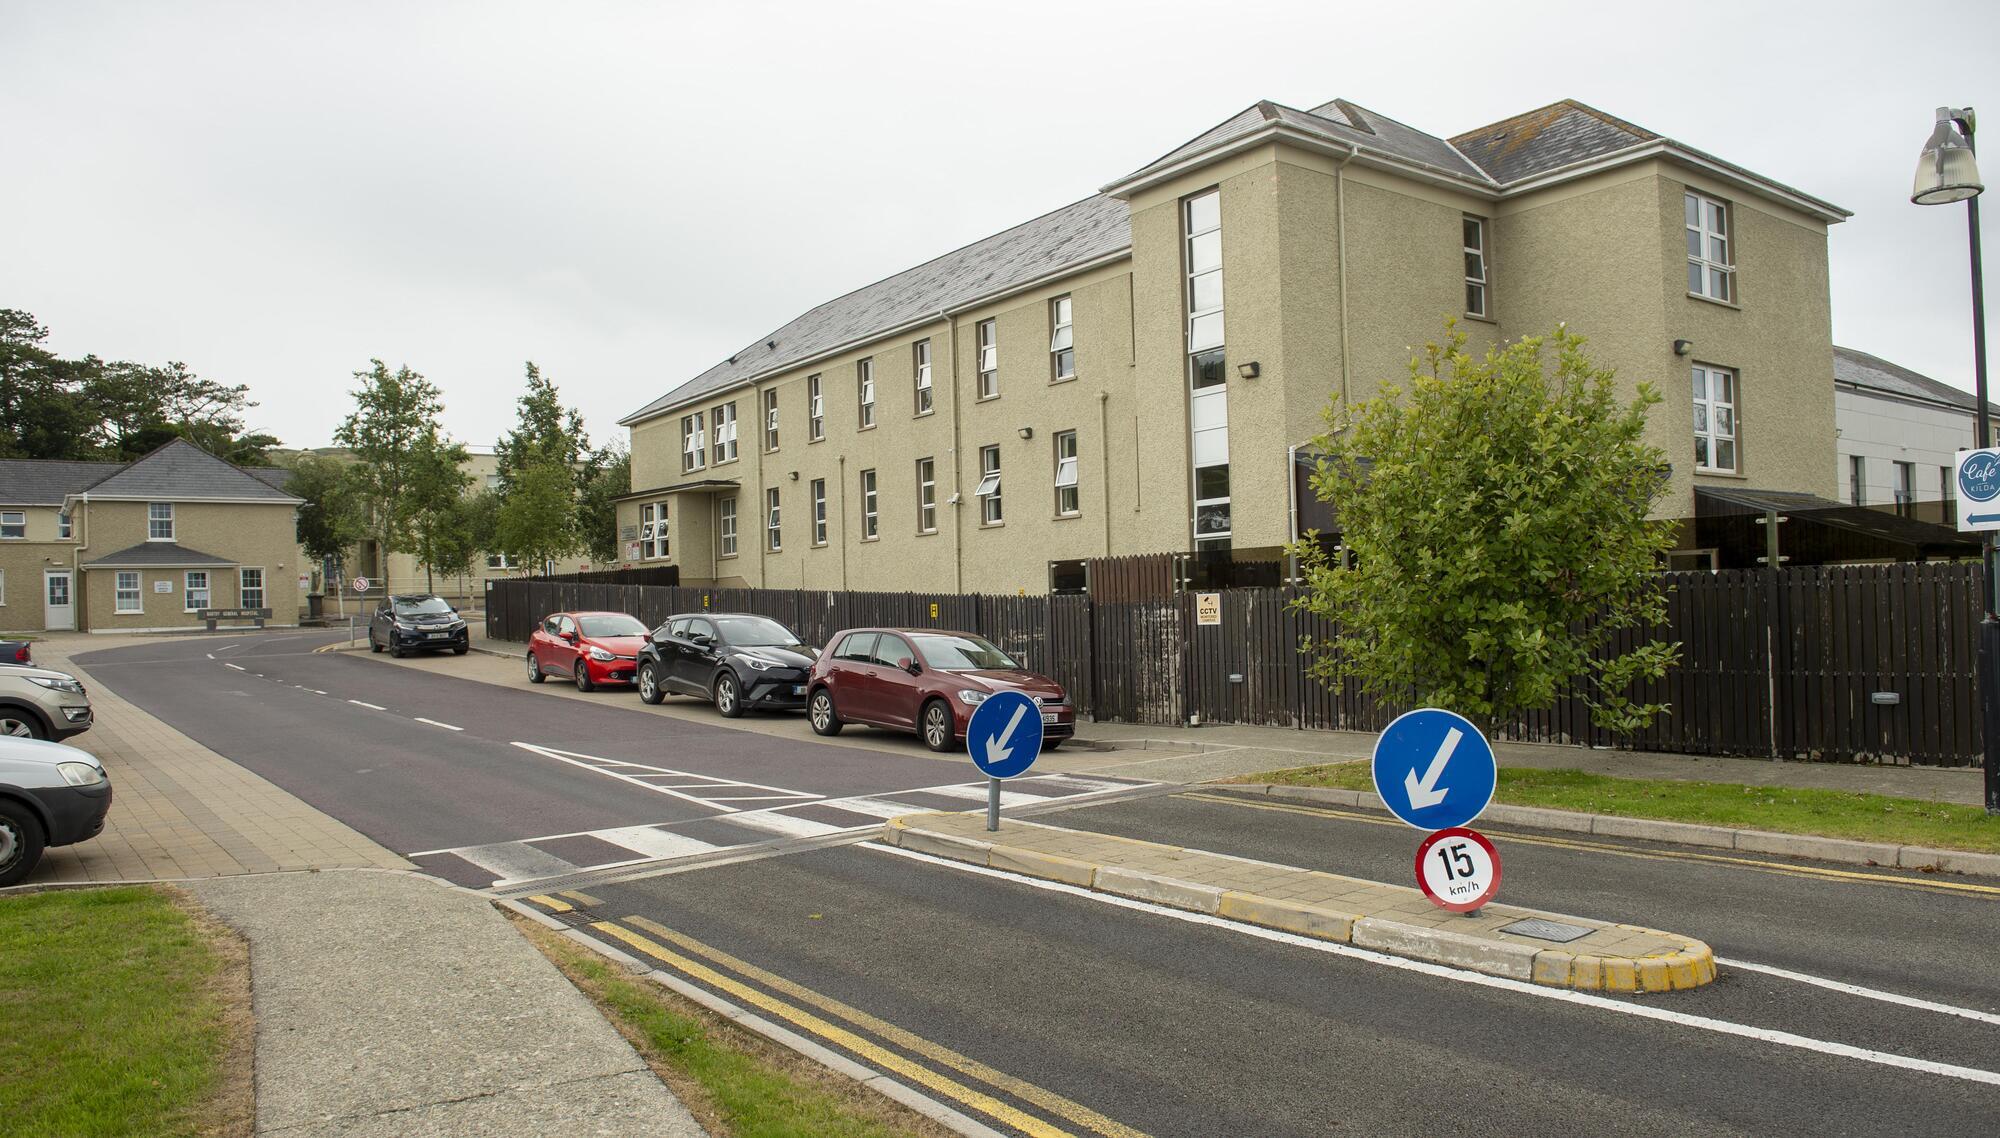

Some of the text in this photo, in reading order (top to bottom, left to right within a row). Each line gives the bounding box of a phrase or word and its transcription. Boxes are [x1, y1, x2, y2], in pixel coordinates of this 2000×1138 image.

[1970, 484, 1995, 492] KILDA
[1437, 843, 1475, 881] 15
[1449, 881, 1480, 896] km/h
